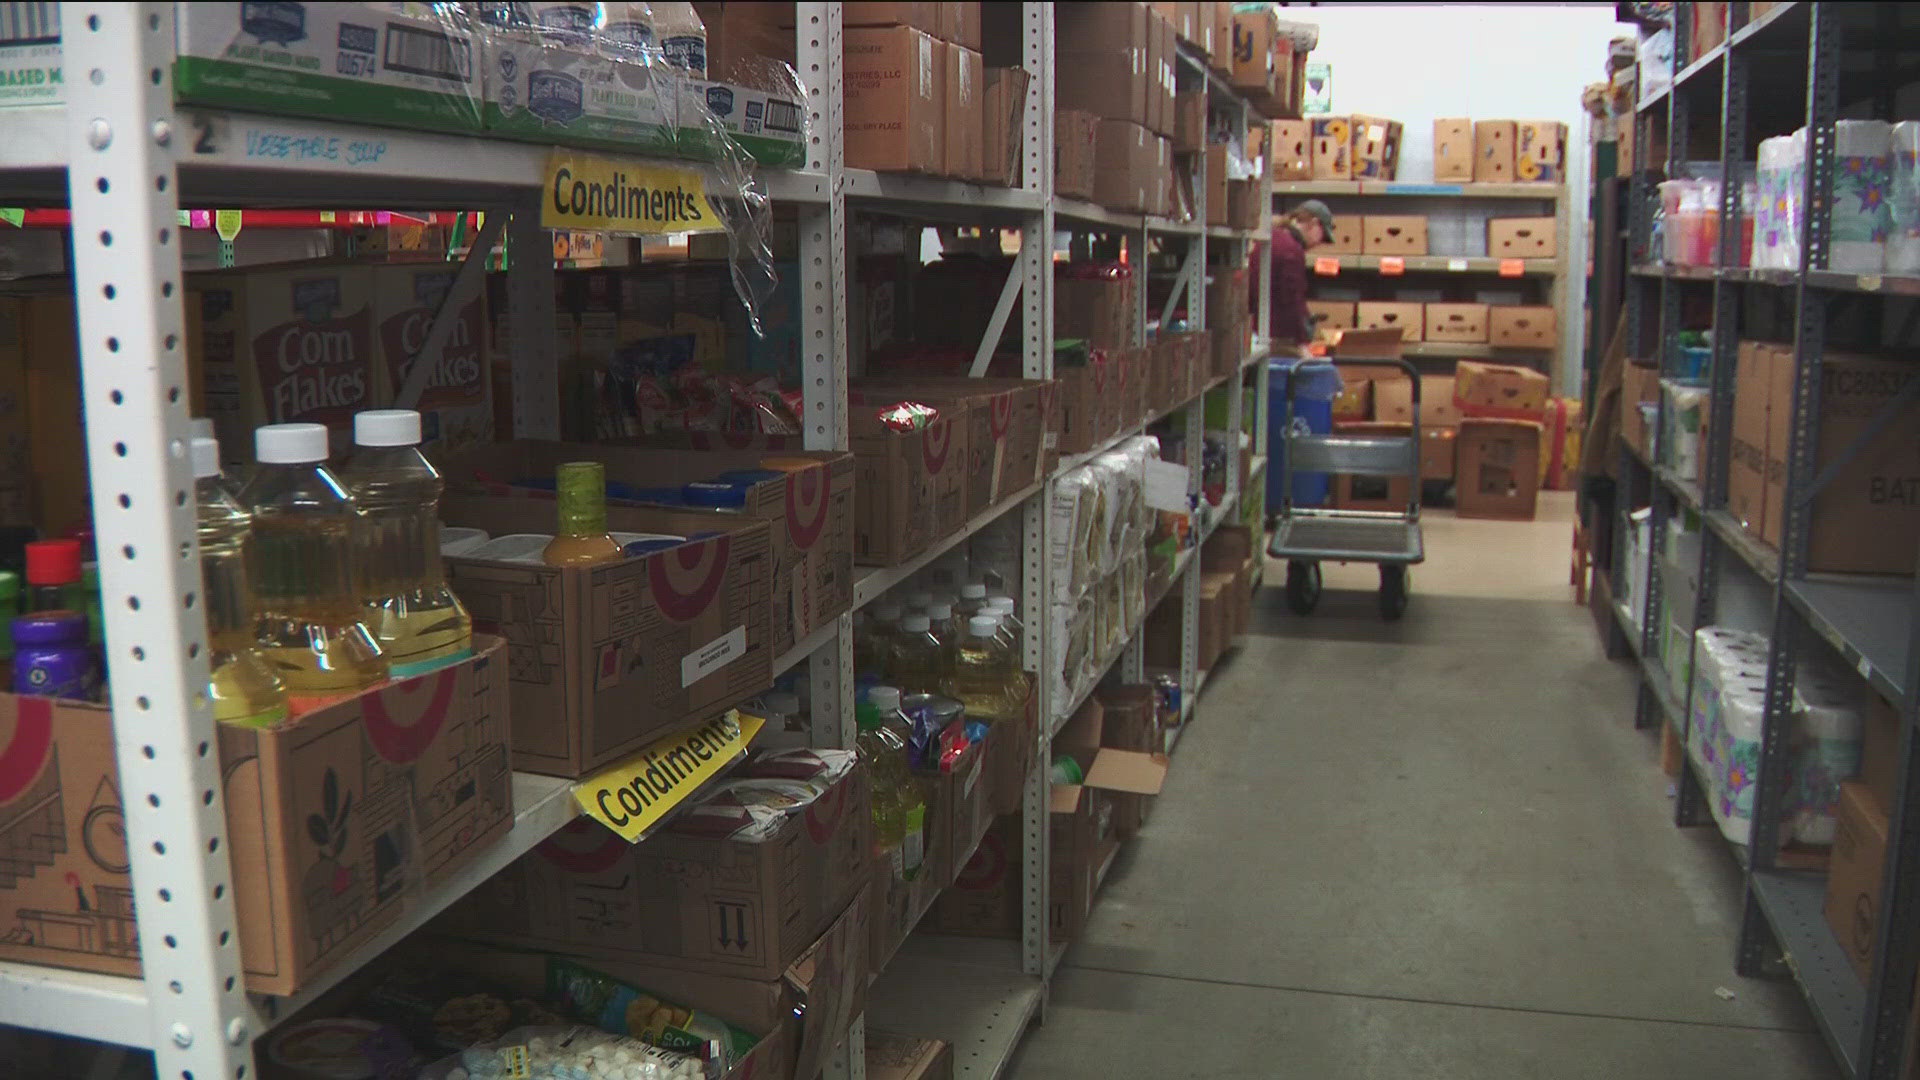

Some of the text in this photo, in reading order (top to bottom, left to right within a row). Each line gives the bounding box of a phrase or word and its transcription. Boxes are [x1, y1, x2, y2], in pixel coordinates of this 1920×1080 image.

[884, 70, 901, 79] LLC
[553, 167, 702, 222] Condiments
[278, 327, 354, 373] Corn
[273, 366, 366, 423] Flakes
